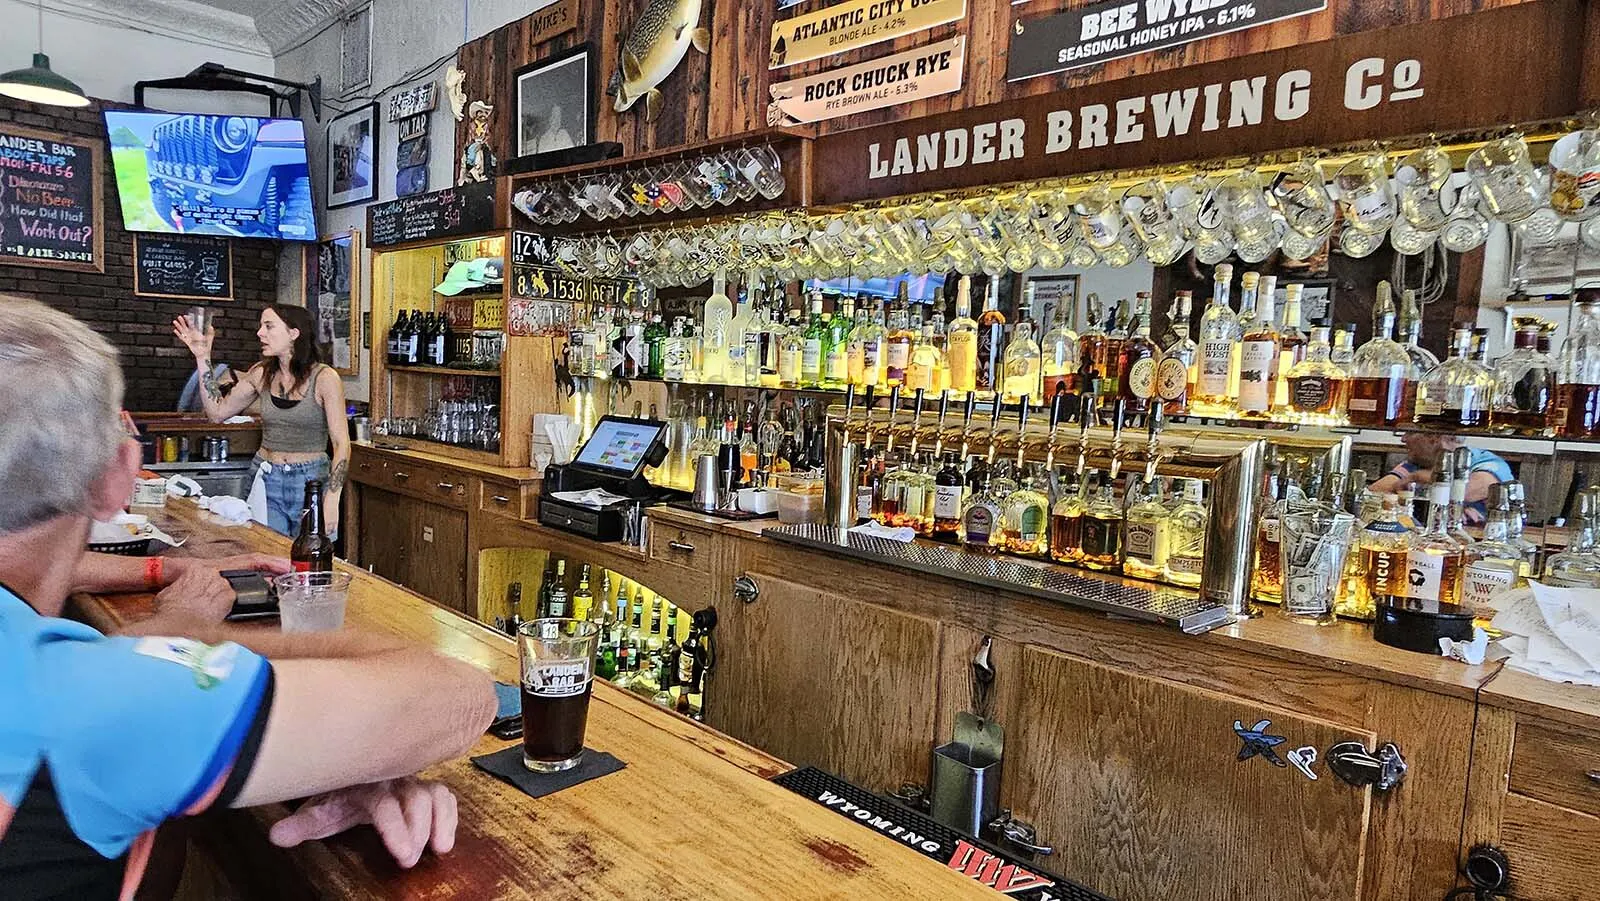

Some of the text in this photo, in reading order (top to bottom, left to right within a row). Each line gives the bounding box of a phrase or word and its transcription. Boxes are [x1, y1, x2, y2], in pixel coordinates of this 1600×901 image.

[532, 7, 567, 37] MIKE'S
[793, 0, 904, 42] ATLANTIC CITY
[829, 30, 859, 46] BLONDE
[861, 24, 877, 36] ALE
[884, 17, 906, 30] 4.2%
[1058, 35, 1128, 63] SEASONAL
[1129, 21, 1179, 47] HONEY
[1180, 15, 1205, 34] IPA
[1217, 3, 1256, 26] 6.1%
[1080, 2, 1138, 41] BEE
[804, 50, 951, 103] ROCK CHUCK RYE
[825, 101, 840, 110] RYE
[842, 92, 871, 107] BROWN
[872, 88, 888, 100] ALE
[895, 82, 918, 95] 5.3%
[399, 114, 426, 138] ON TAP
[868, 118, 1026, 179] LANDER
[1045, 69, 1311, 154] BREWING
[38, 154, 65, 166] TAPS
[51, 144, 76, 157] BAR
[16, 188, 40, 203] No
[11, 204, 36, 216] How
[40, 208, 57, 220] Did
[20, 217, 92, 247] Work Out?
[516, 234, 531, 256] 12
[517, 275, 526, 296] 8
[552, 279, 583, 301] 1536
[1205, 342, 1231, 351] HIGH
[1205, 351, 1230, 359] WEST
[1465, 591, 1491, 604] WHIS
[818, 790, 941, 853] WYOMING
